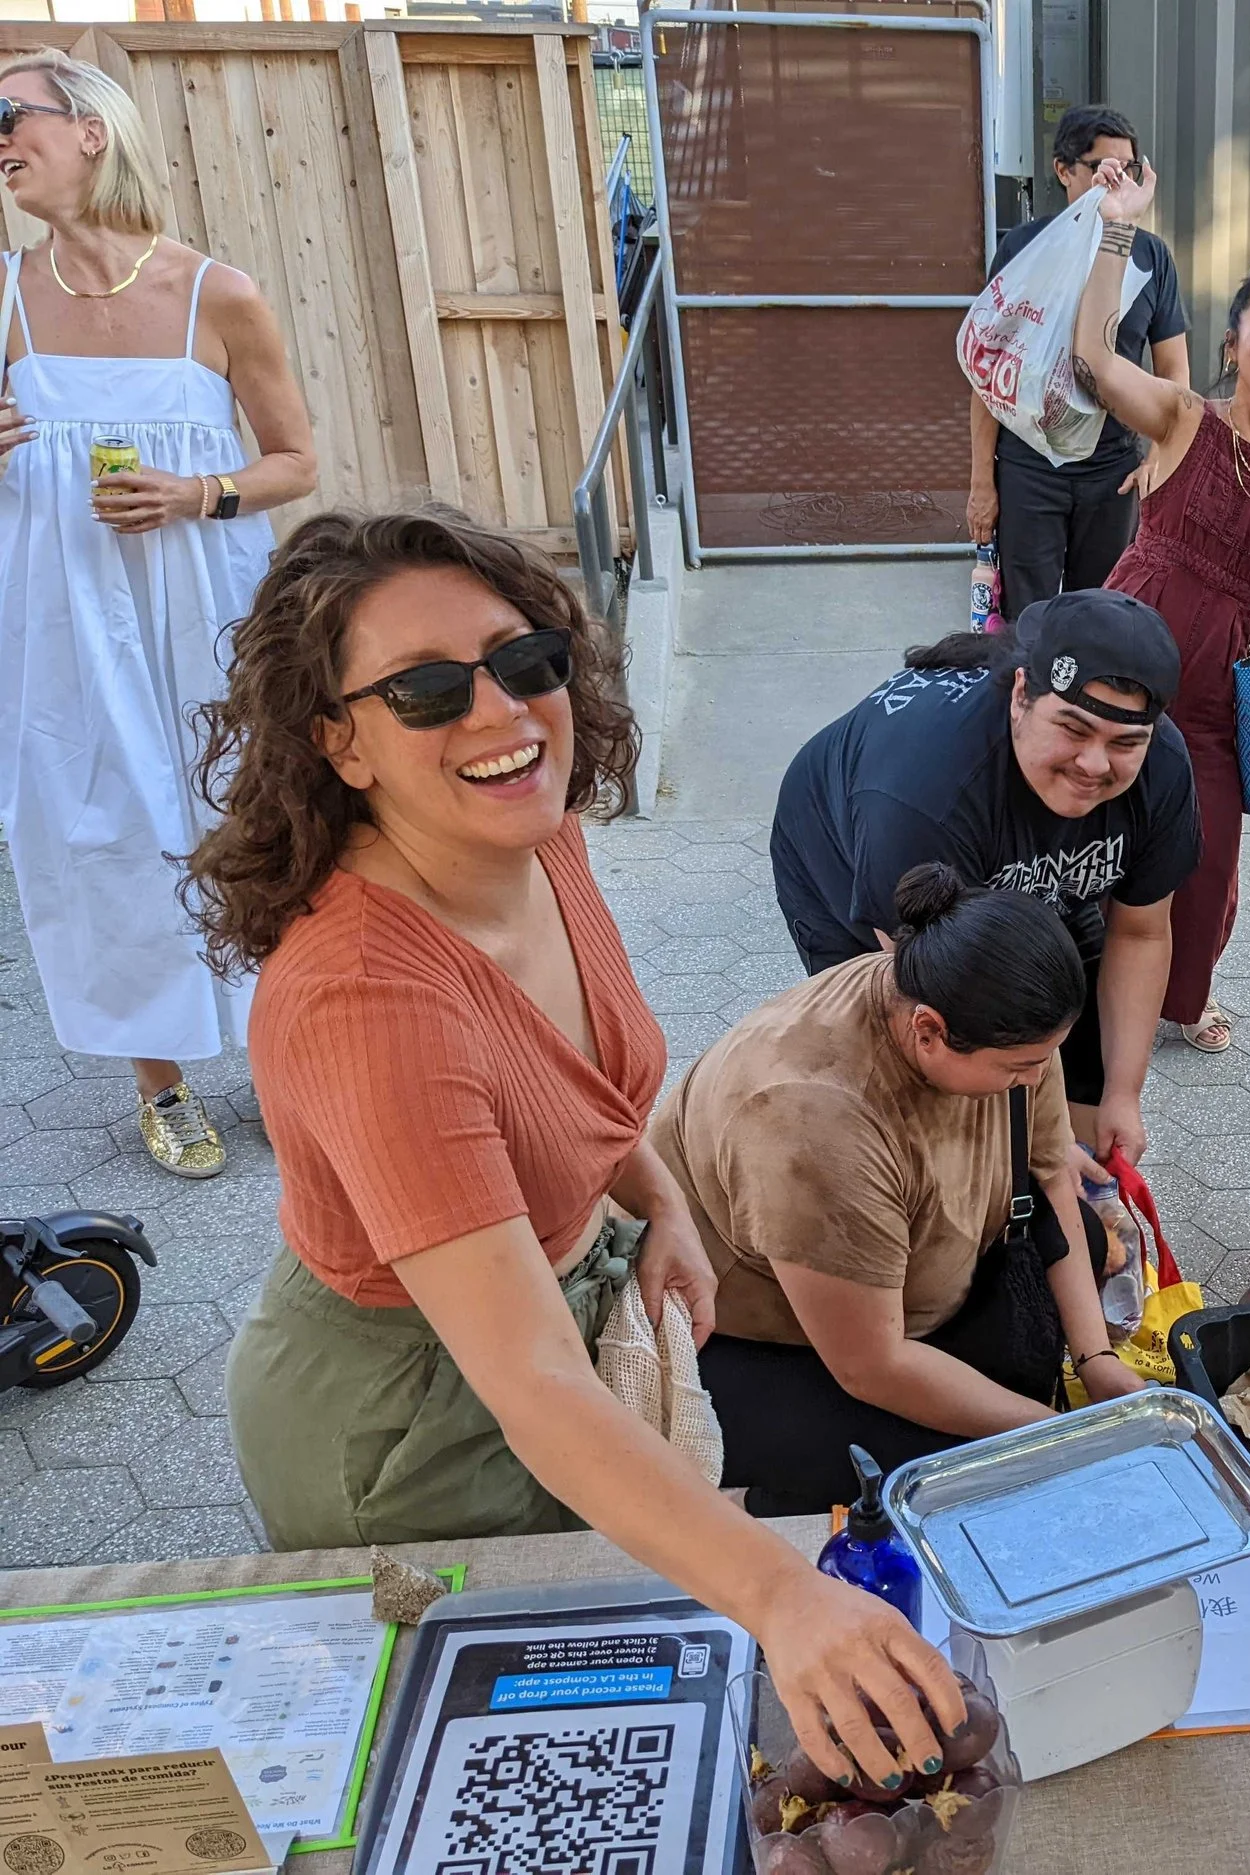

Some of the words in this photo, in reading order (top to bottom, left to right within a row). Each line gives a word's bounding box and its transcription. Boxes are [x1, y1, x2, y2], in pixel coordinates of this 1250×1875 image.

[1193, 1573, 1221, 1584] We
[1201, 1596, 1238, 1619] 我
[567, 1640, 599, 1650] follow
[601, 1639, 621, 1649] and
[622, 1637, 647, 1647] Click
[648, 1636, 659, 1646] 3)
[526, 1643, 546, 1653] link
[548, 1642, 565, 1651] the
[647, 1646, 657, 1655] 2)
[523, 1652, 549, 1662] code
[550, 1650, 565, 1661] QR
[567, 1650, 587, 1660] this
[588, 1648, 612, 1658] over
[614, 1647, 645, 1657] Hover
[549, 1660, 588, 1669] camera
[589, 1656, 614, 1667] your
[616, 1655, 643, 1666] Open
[644, 1655, 655, 1664] 1)
[527, 1660, 547, 1670] app
[514, 1676, 541, 1688] app:
[543, 1674, 597, 1687] Compost
[600, 1675, 615, 1685] LA
[618, 1673, 639, 1684] the
[642, 1672, 654, 1682] in
[518, 1686, 547, 1701] drop
[549, 1683, 580, 1698] your
[581, 1685, 623, 1697] record
[624, 1683, 664, 1695] Please
[496, 1692, 515, 1703] off
[129, 1764, 161, 1776] para
[164, 1759, 216, 1771] reducir
[48, 1782, 73, 1791] sus
[75, 1777, 120, 1788] restos
[123, 1774, 139, 1783] de
[142, 1769, 196, 1782] comida?
